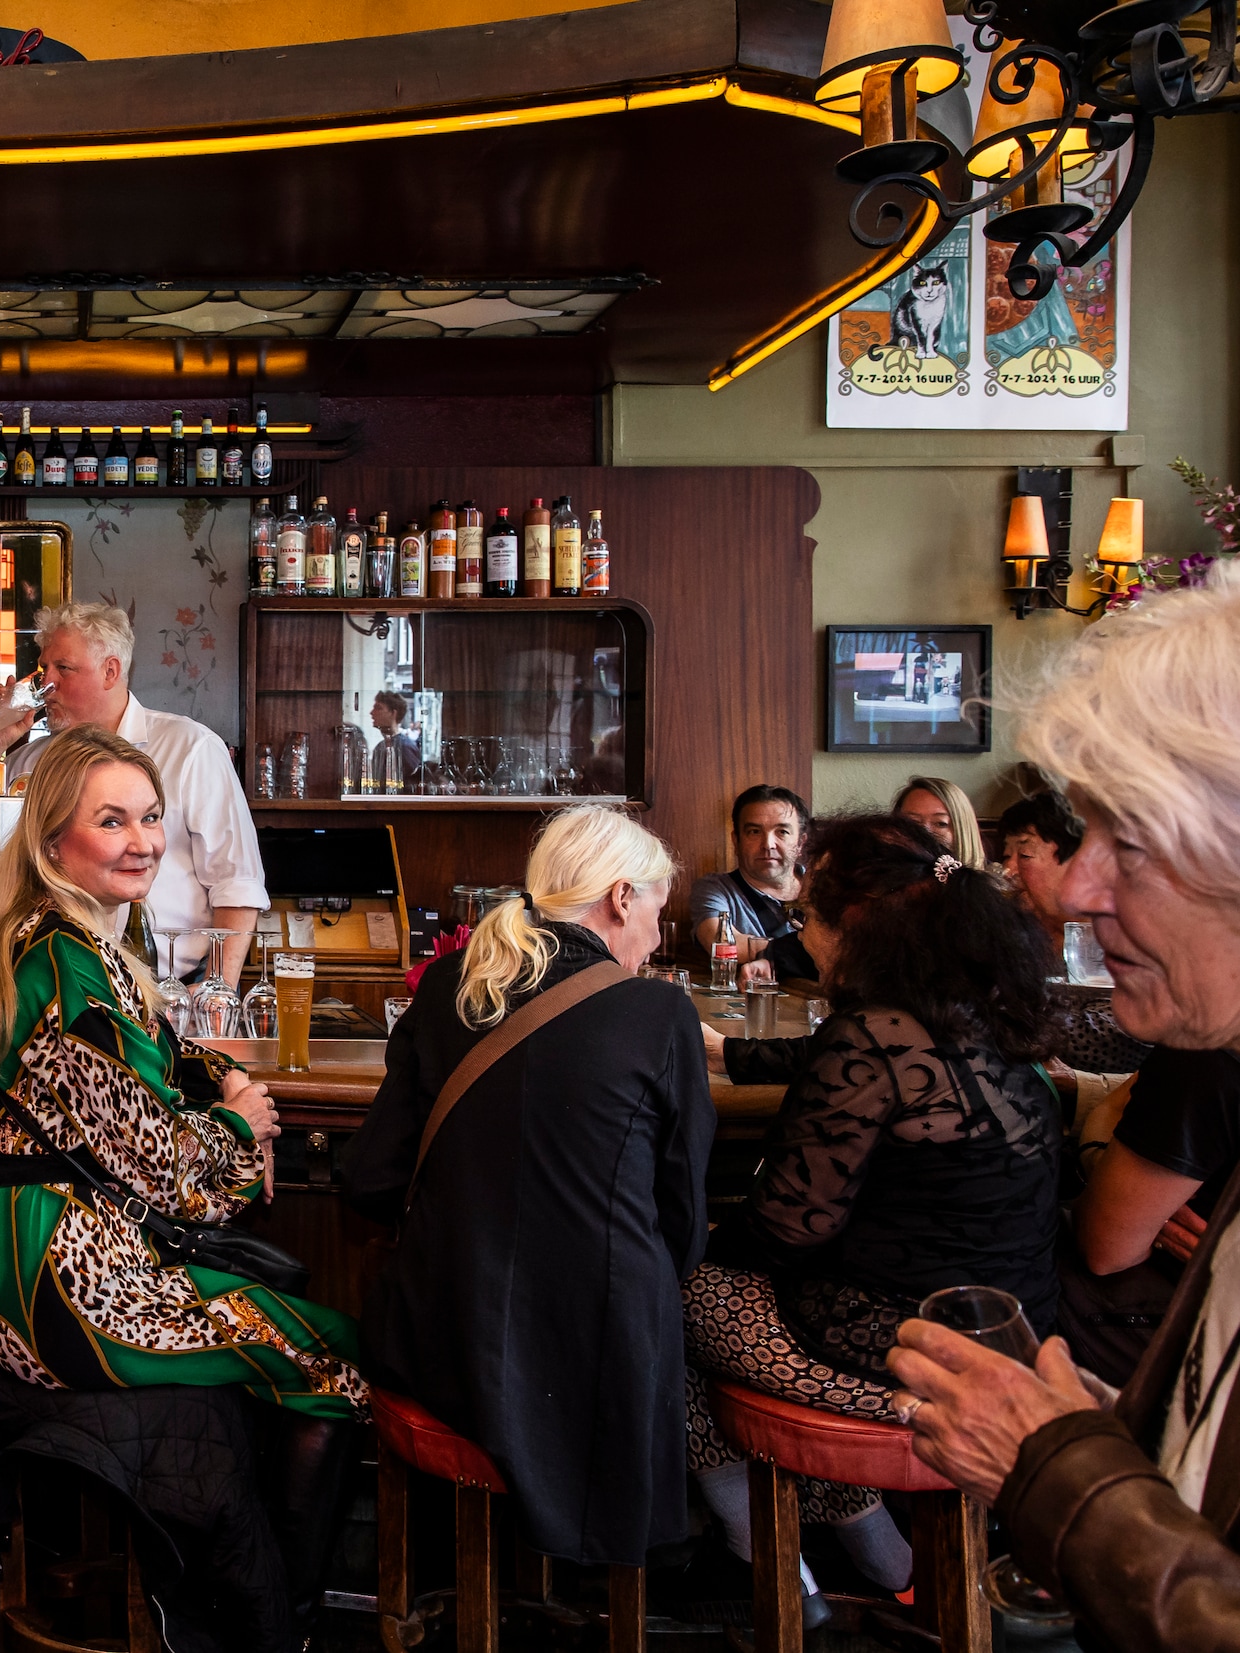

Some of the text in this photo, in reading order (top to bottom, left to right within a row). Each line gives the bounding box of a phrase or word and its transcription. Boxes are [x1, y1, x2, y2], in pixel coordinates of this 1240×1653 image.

[855, 374, 912, 383] 7-7-2024
[1001, 374, 1101, 384] 7-7-2024 16 UUR
